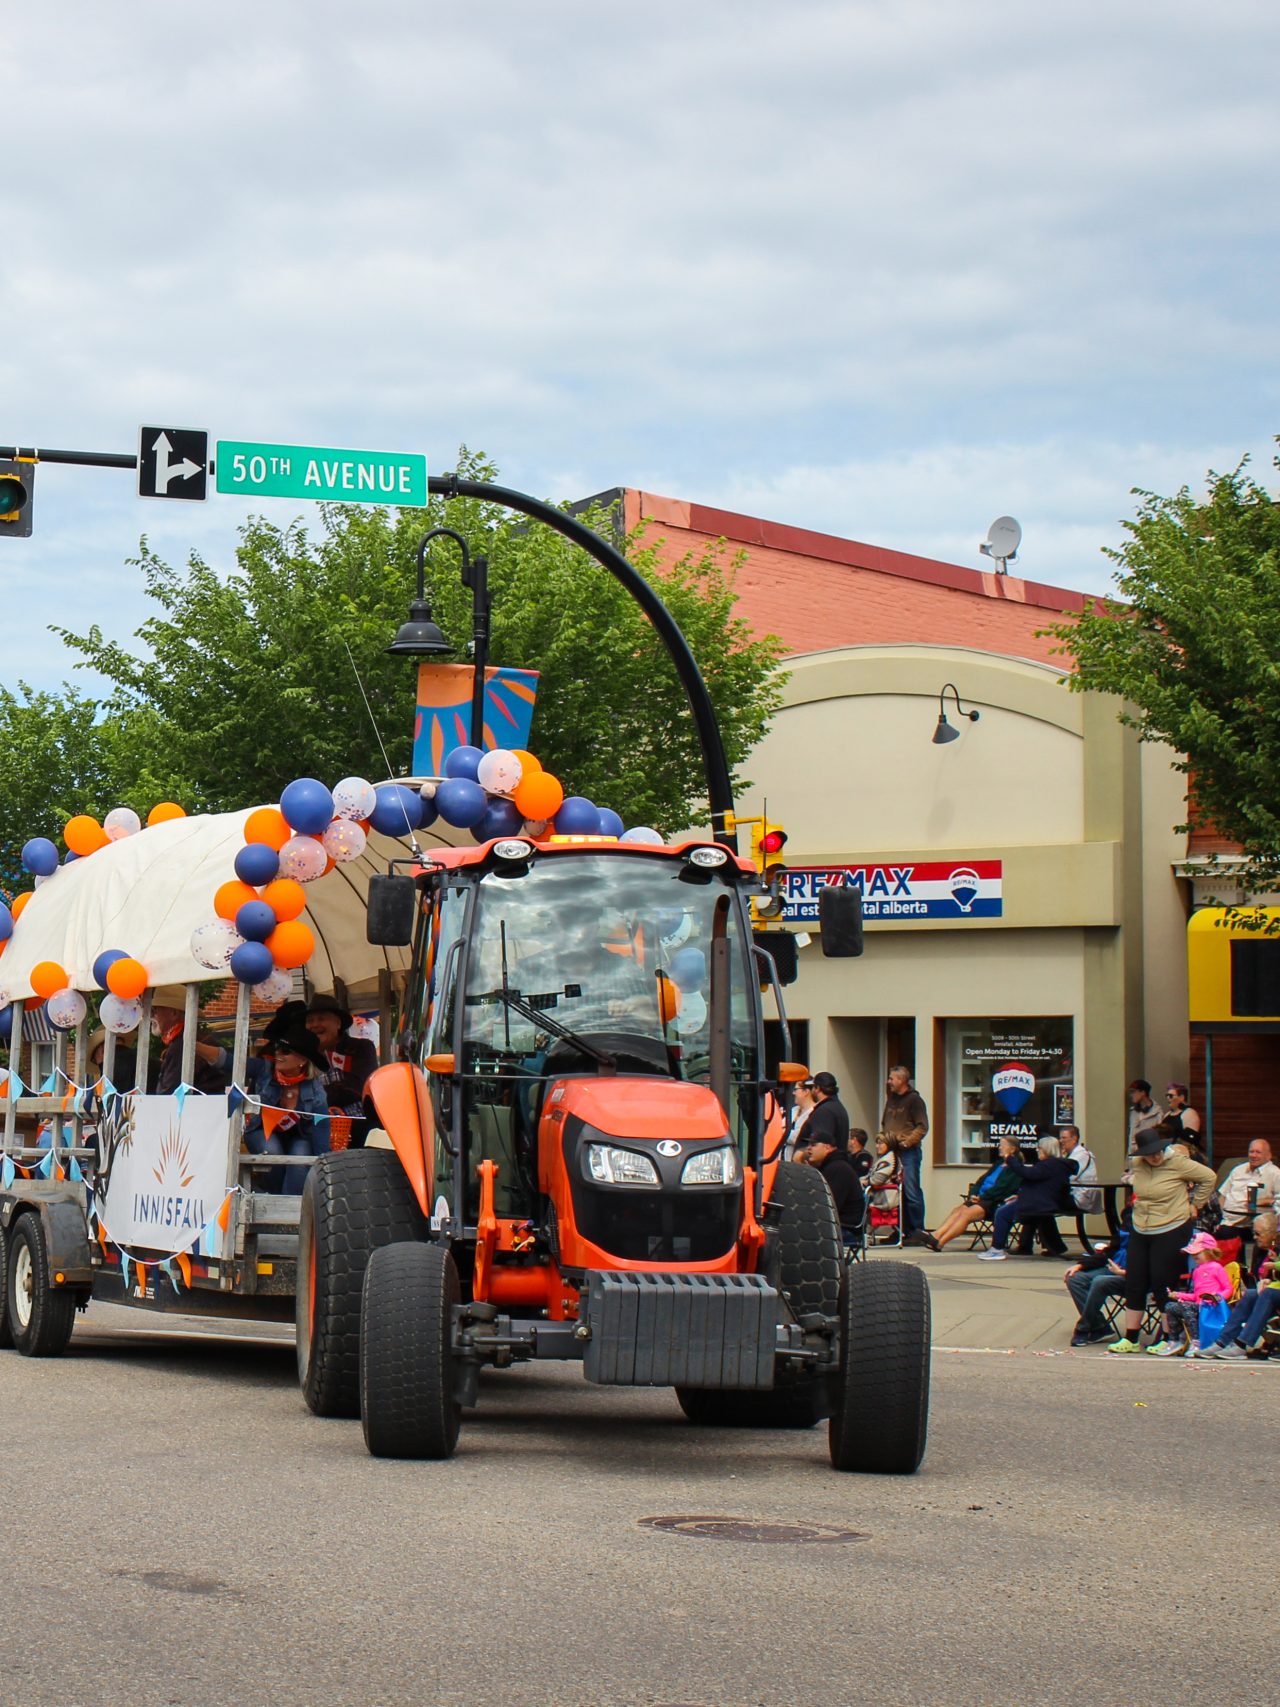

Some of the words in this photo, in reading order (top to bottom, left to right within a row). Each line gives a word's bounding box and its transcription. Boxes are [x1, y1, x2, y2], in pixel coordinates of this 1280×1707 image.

[232, 454, 291, 483] 50TH
[303, 460, 412, 493] AVENUE
[781, 903, 798, 916] eal
[800, 903, 820, 916] est
[863, 902, 880, 915] tal
[882, 901, 928, 914] alberta
[965, 1048, 984, 1056] Open
[984, 1048, 1011, 1056] Monday
[997, 1074, 1031, 1086] RE/MAX
[989, 1123, 1037, 1135] RE/MAX
[133, 1193, 207, 1230] INNISFAIL
